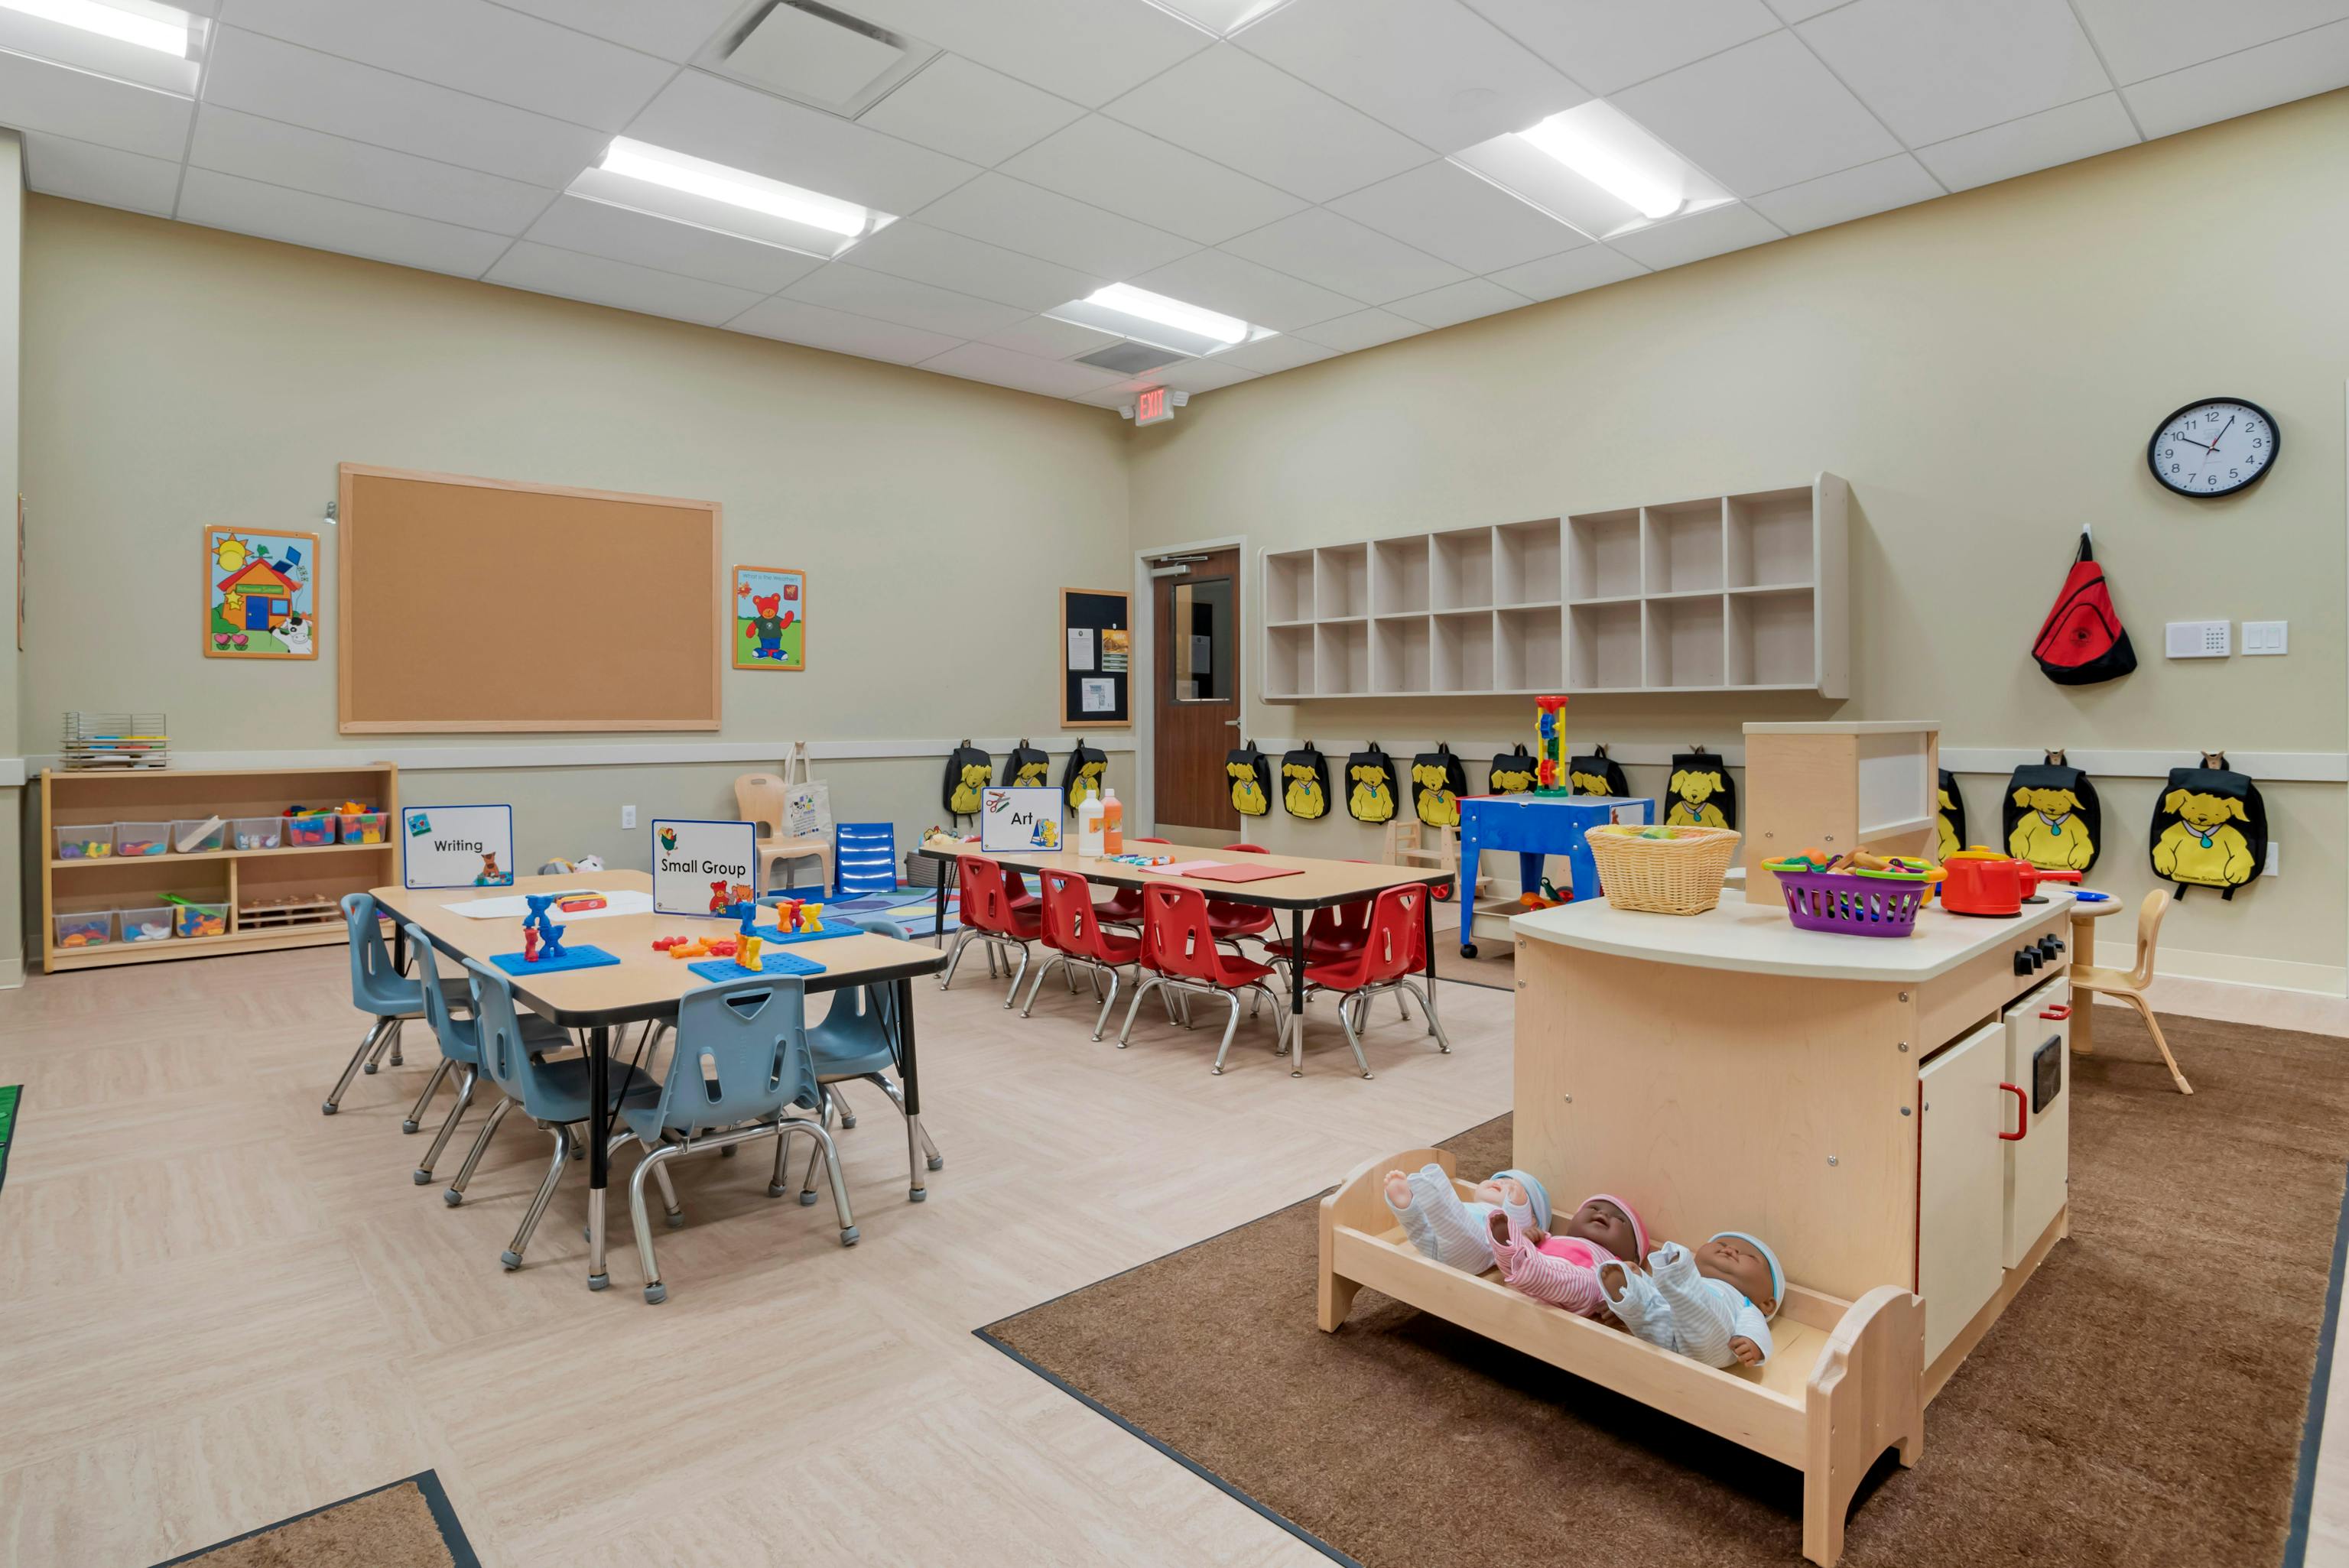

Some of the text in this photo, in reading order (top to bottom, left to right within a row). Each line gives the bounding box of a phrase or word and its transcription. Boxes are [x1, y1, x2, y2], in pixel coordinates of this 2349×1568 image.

[1140, 388, 1164, 420] EXIT
[2204, 411, 2220, 423] 12
[2229, 414, 2235, 424] 1
[2185, 420, 2197, 430] 11
[2245, 422, 2255, 433] 2
[2171, 431, 2185, 442] 10
[2253, 438, 2262, 448] 3
[2165, 449, 2173, 459] 9
[2245, 455, 2255, 465] 4
[2172, 463, 2180, 473] 8
[2188, 473, 2197, 483] 7
[2229, 469, 2238, 479] 5
[2208, 475, 2217, 485] 6
[1011, 812, 1033, 825] Art
[434, 839, 482, 853] Writing
[661, 859, 746, 878] Small Group
